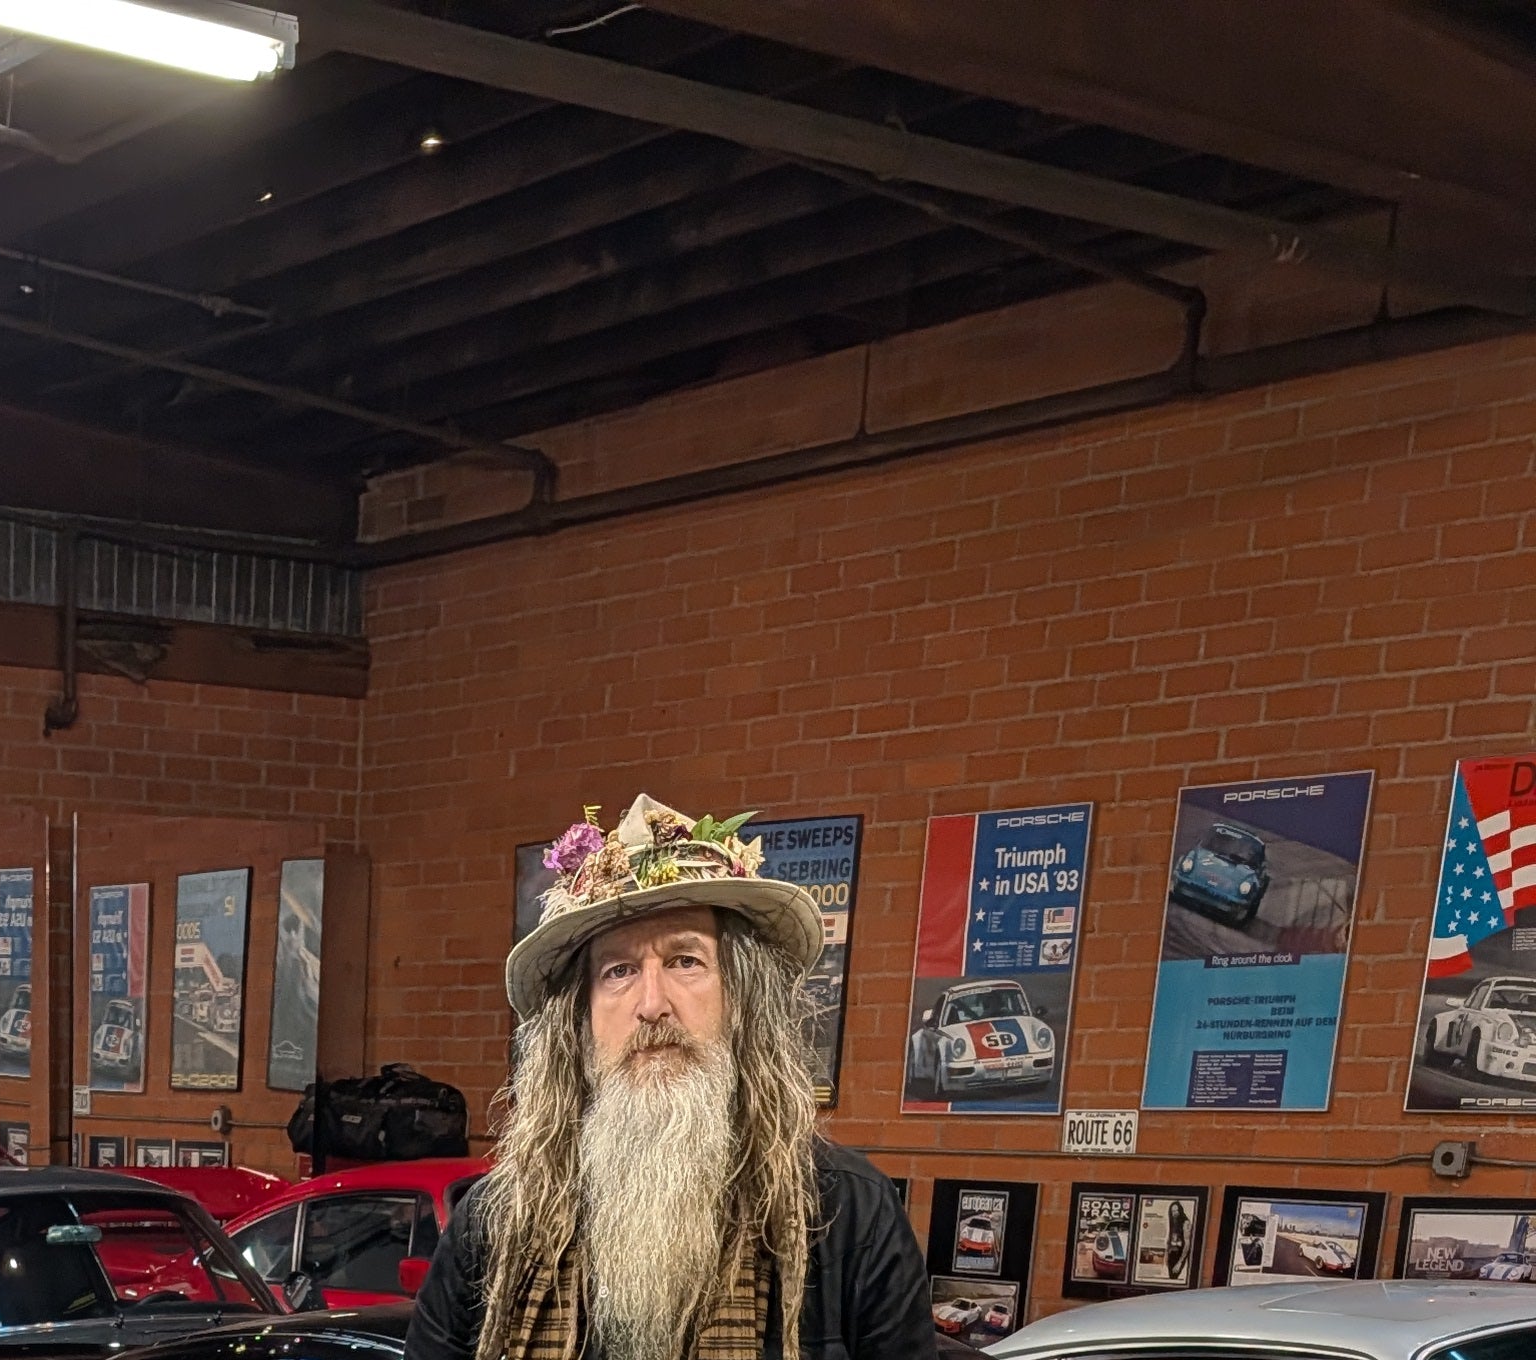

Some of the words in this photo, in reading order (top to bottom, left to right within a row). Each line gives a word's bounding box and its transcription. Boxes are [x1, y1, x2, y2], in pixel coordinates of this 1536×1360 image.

[1223, 785, 1325, 803] PORSCHE
[996, 811, 1085, 829] PORSCHE
[786, 825, 854, 851] SWEEPS
[994, 843, 1067, 870] Triumph
[778, 857, 851, 881] SEBRING
[994, 874, 1011, 896] in
[1013, 871, 1050, 895] USA
[1053, 869, 1079, 892] '93
[802, 883, 850, 907] 000
[1230, 954, 1257, 965] around
[1258, 954, 1272, 964] the
[1273, 952, 1293, 963] clock
[985, 1033, 1014, 1048] 58
[1067, 1119, 1110, 1146] ROUTE
[1113, 1119, 1133, 1146] 66
[1081, 1200, 1121, 1211] ROAD
[1081, 1209, 1131, 1219] TRACK
[1426, 1246, 1458, 1260] NEW
[1414, 1258, 1465, 1272] LEGEND
